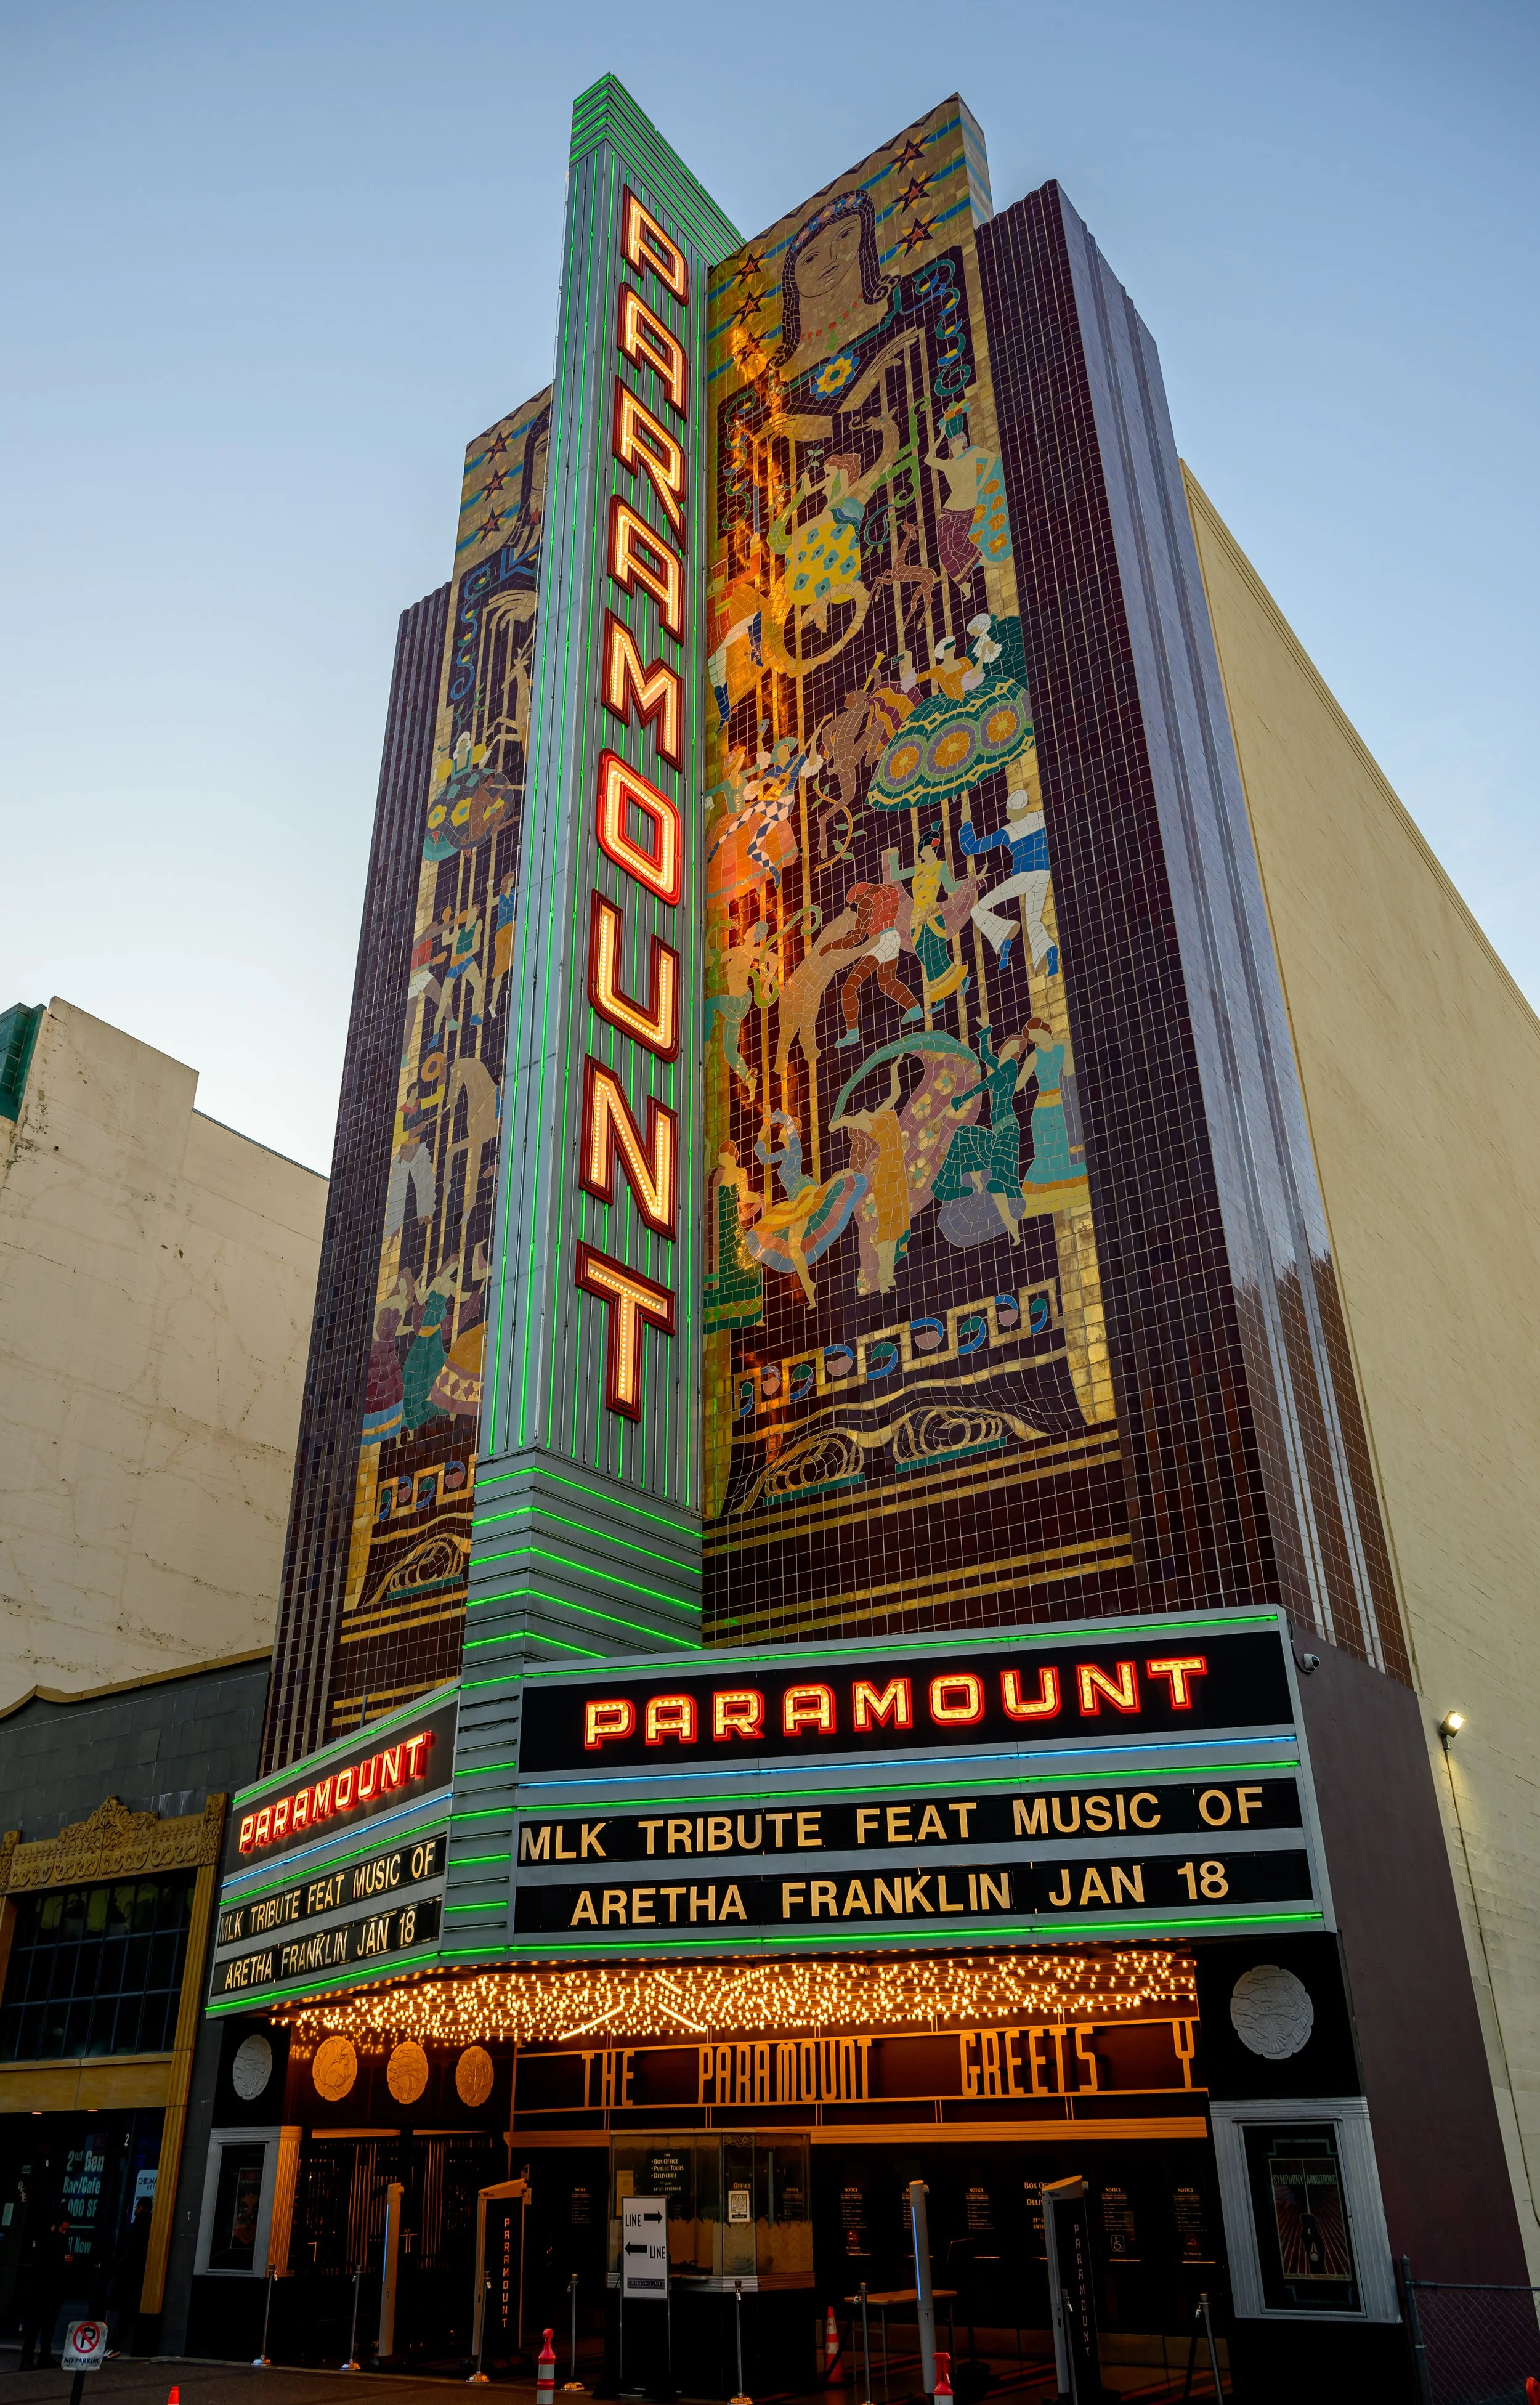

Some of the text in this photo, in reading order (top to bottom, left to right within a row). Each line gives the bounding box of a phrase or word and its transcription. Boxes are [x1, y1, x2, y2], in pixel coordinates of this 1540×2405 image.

[575, 183, 689, 1424] PARAMOUNT
[585, 1655, 1208, 1750] PARAMOUNT
[238, 1730, 434, 1854] PARAMOUNT
[520, 1786, 1263, 1861] MLK TRIBUTE FEAT MUSIC OF
[219, 1841, 436, 1942] MLK TRIBUTE FEAT MUSIC OF
[570, 1860, 1229, 1926] ARETHA FRANKLIN JAN 18
[225, 1910, 416, 1990] ARETHA FRANKLIN JAN 18
[582, 2020, 1195, 2107] THE PARAMOUNT GREETS Y
[63, 2176, 102, 2194] Bar/Cafe
[67, 2149, 105, 2172] 2nd Gen
[1273, 2173, 1338, 2186] SYMPHONY ARMSTRONG
[74, 2237, 92, 2254] Now
[86, 2198, 99, 2218] SF
[625, 2213, 641, 2227] LINE
[502, 2218, 511, 2329] PARAMOUNT
[650, 2245, 665, 2259] LINE
[1074, 2223, 1090, 2357] PARAMOUNT
